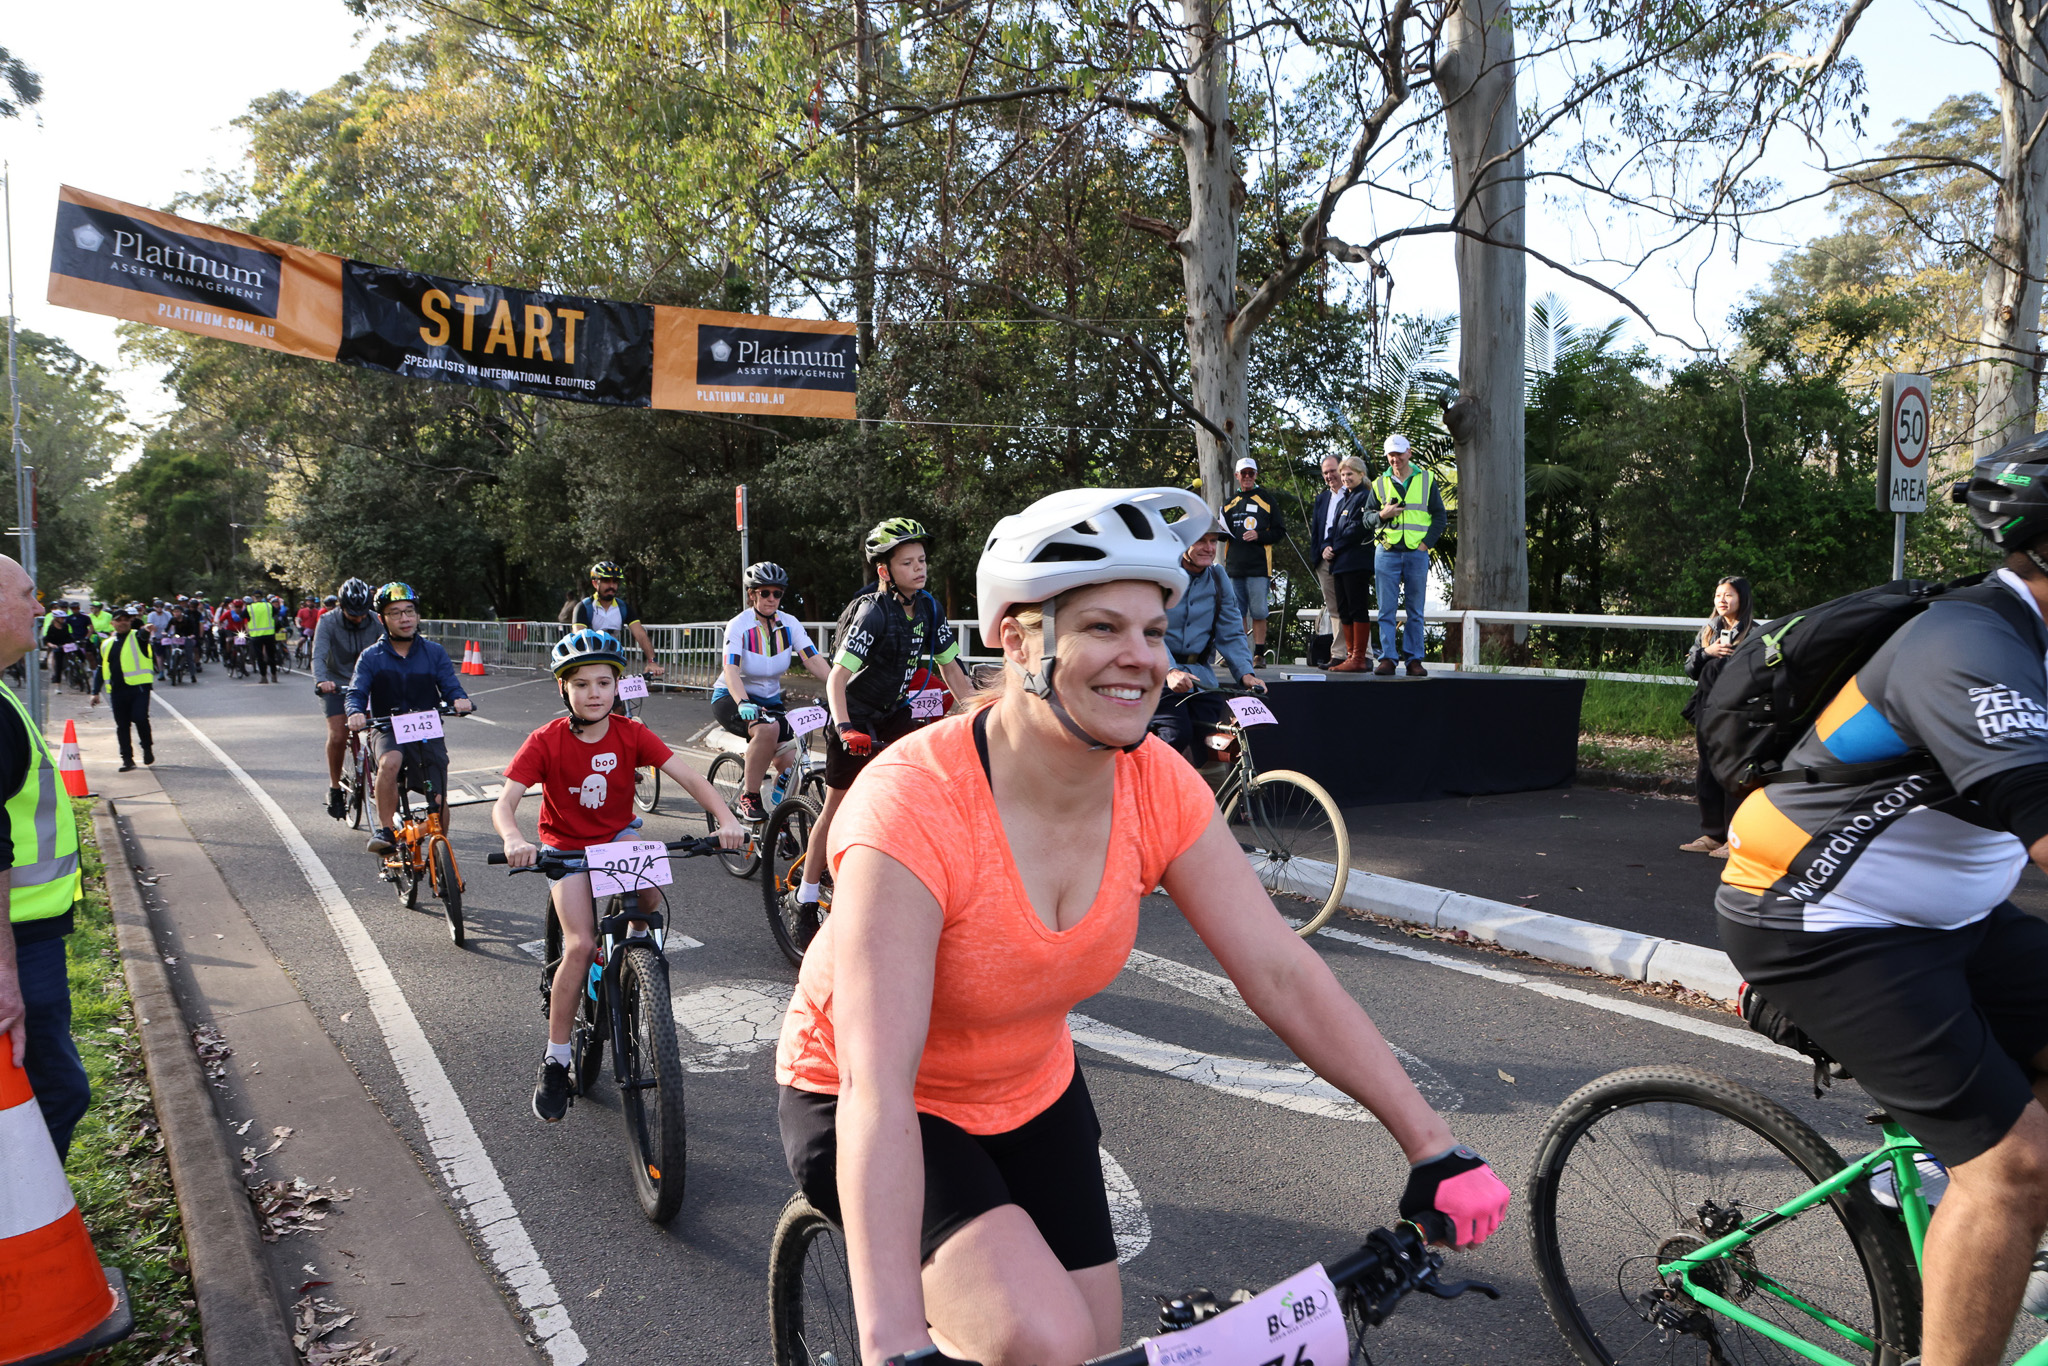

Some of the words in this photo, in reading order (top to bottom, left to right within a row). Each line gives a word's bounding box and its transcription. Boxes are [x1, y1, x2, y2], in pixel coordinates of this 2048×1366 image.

[112, 229, 264, 288] Platinum
[110, 262, 156, 278] ASSET
[162, 272, 263, 300] MANAGEMENT
[158, 303, 276, 338] PLATINUM.COM.AU
[419, 289, 585, 365] START
[737, 340, 846, 369] Platinum
[404, 354, 465, 374] SPECIALISTS
[467, 365, 478, 376] IN
[480, 367, 552, 385] INTERNATIONAL
[555, 376, 597, 391] EQUITIES
[737, 367, 769, 375] ASSET
[774, 368, 846, 379] MANAGEMENT
[696, 390, 785, 405] PLATINUM.COM.AU
[1899, 409, 1923, 445] 50
[1891, 478, 1926, 502] AREA
[797, 712, 823, 726] 2232
[1241, 706, 1267, 716] 2084
[403, 721, 433, 733] 2143
[595, 758, 615, 768] boo
[604, 855, 655, 877] 2074
